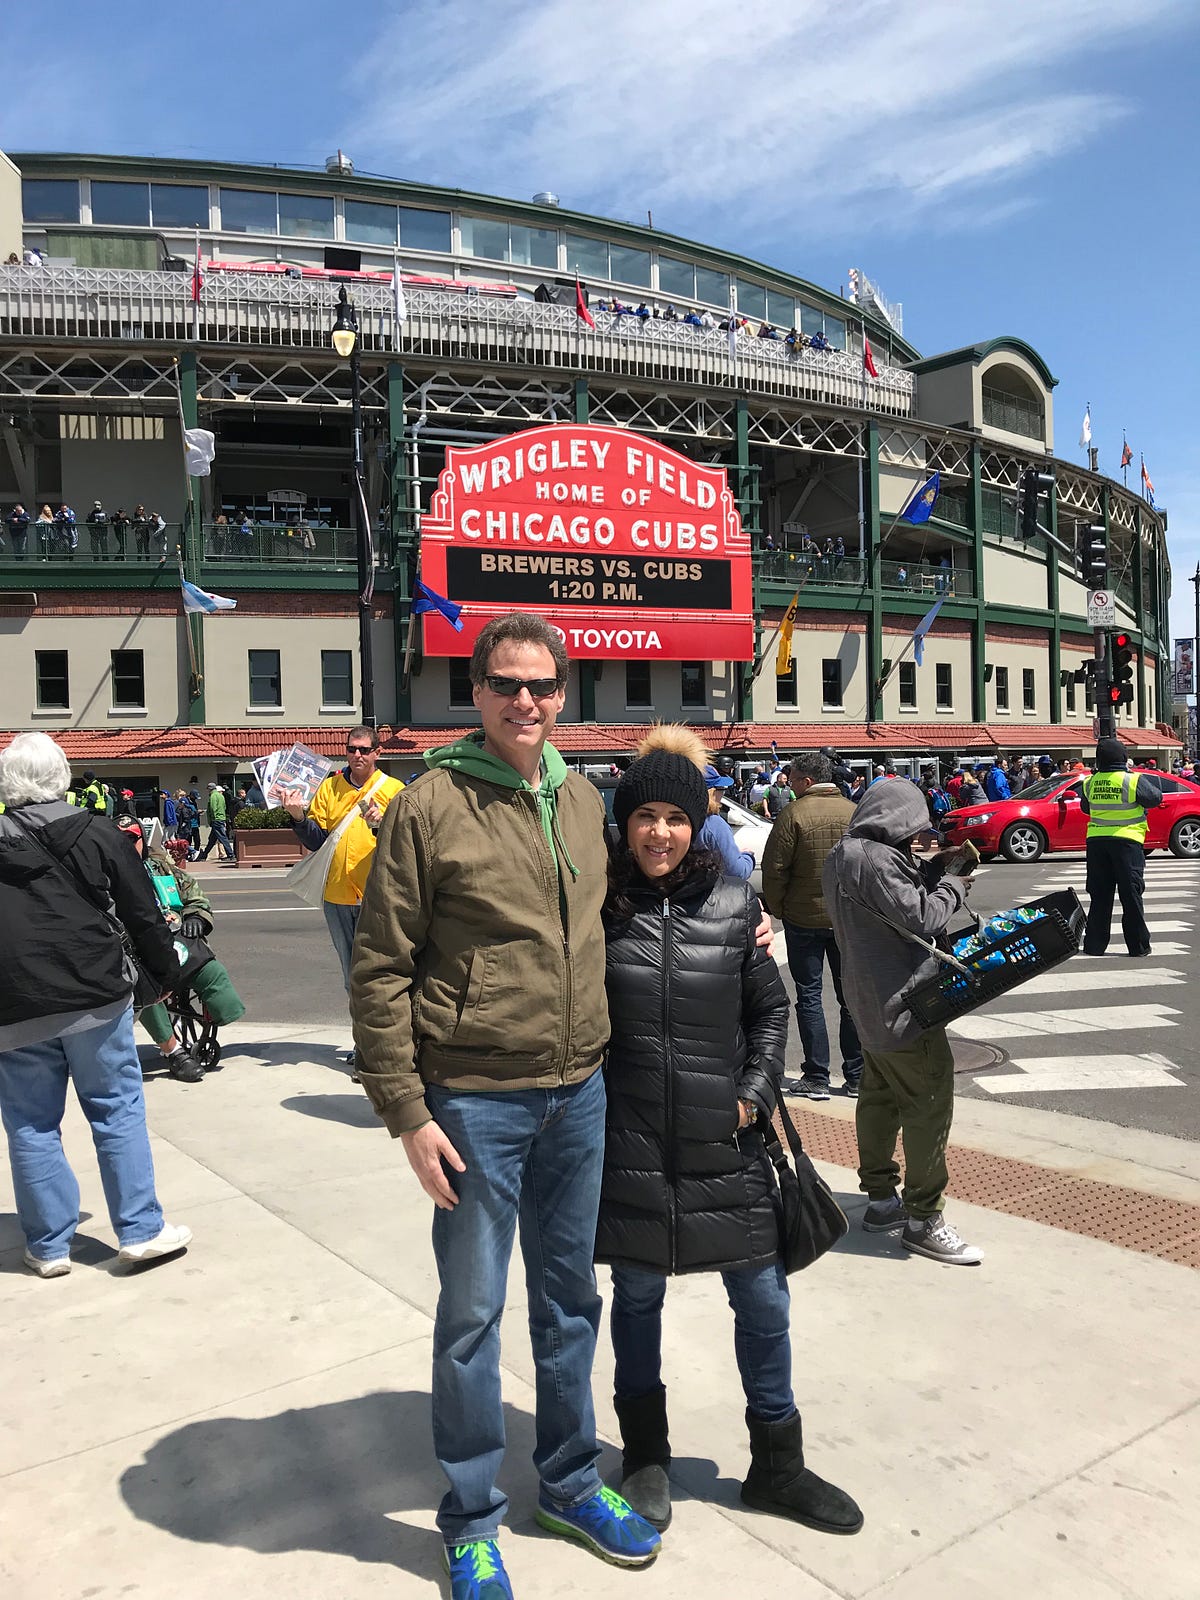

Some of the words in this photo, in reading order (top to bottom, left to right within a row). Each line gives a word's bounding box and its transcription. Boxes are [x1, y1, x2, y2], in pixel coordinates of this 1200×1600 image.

[460, 440, 611, 494] WRIGLEY
[626, 446, 717, 509] FIELD
[535, 482, 605, 504] HOME
[621, 488, 652, 507] OF
[460, 508, 615, 546] CHICAGO
[631, 520, 719, 551] CUBS
[480, 553, 595, 577] BREWERS
[601, 559, 637, 578] VS.
[643, 561, 703, 581] CUBS
[548, 580, 595, 600] 1:20
[602, 582, 643, 601] P.M.
[569, 628, 663, 650] TOYOTA
